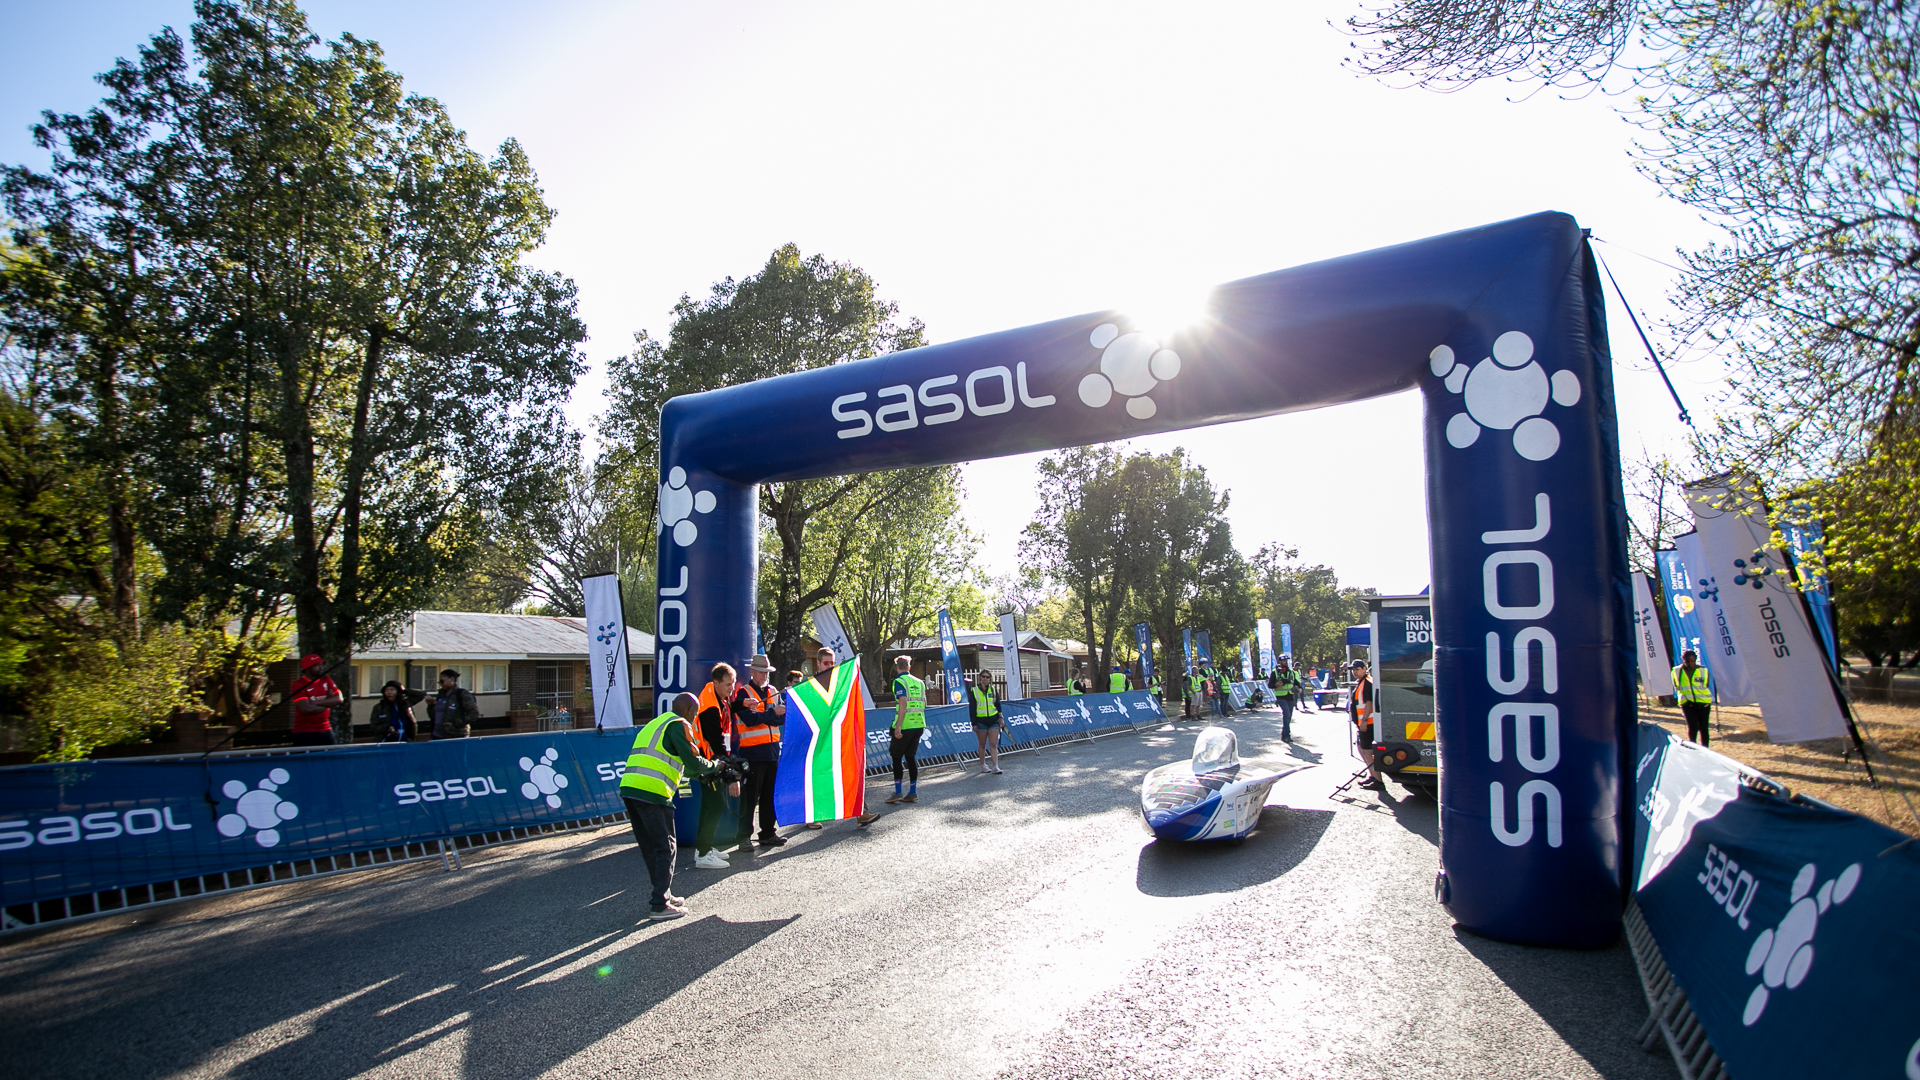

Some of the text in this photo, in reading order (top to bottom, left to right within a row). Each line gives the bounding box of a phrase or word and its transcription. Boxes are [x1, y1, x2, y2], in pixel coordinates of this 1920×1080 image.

[831, 361, 1056, 439] SASOL
[1716, 609, 1736, 656] SASOL
[1758, 597, 1790, 659] SASOL
[1481, 493, 1562, 848] SASOL
[393, 775, 508, 805] SASOL
[1697, 843, 1760, 931] SASOL
